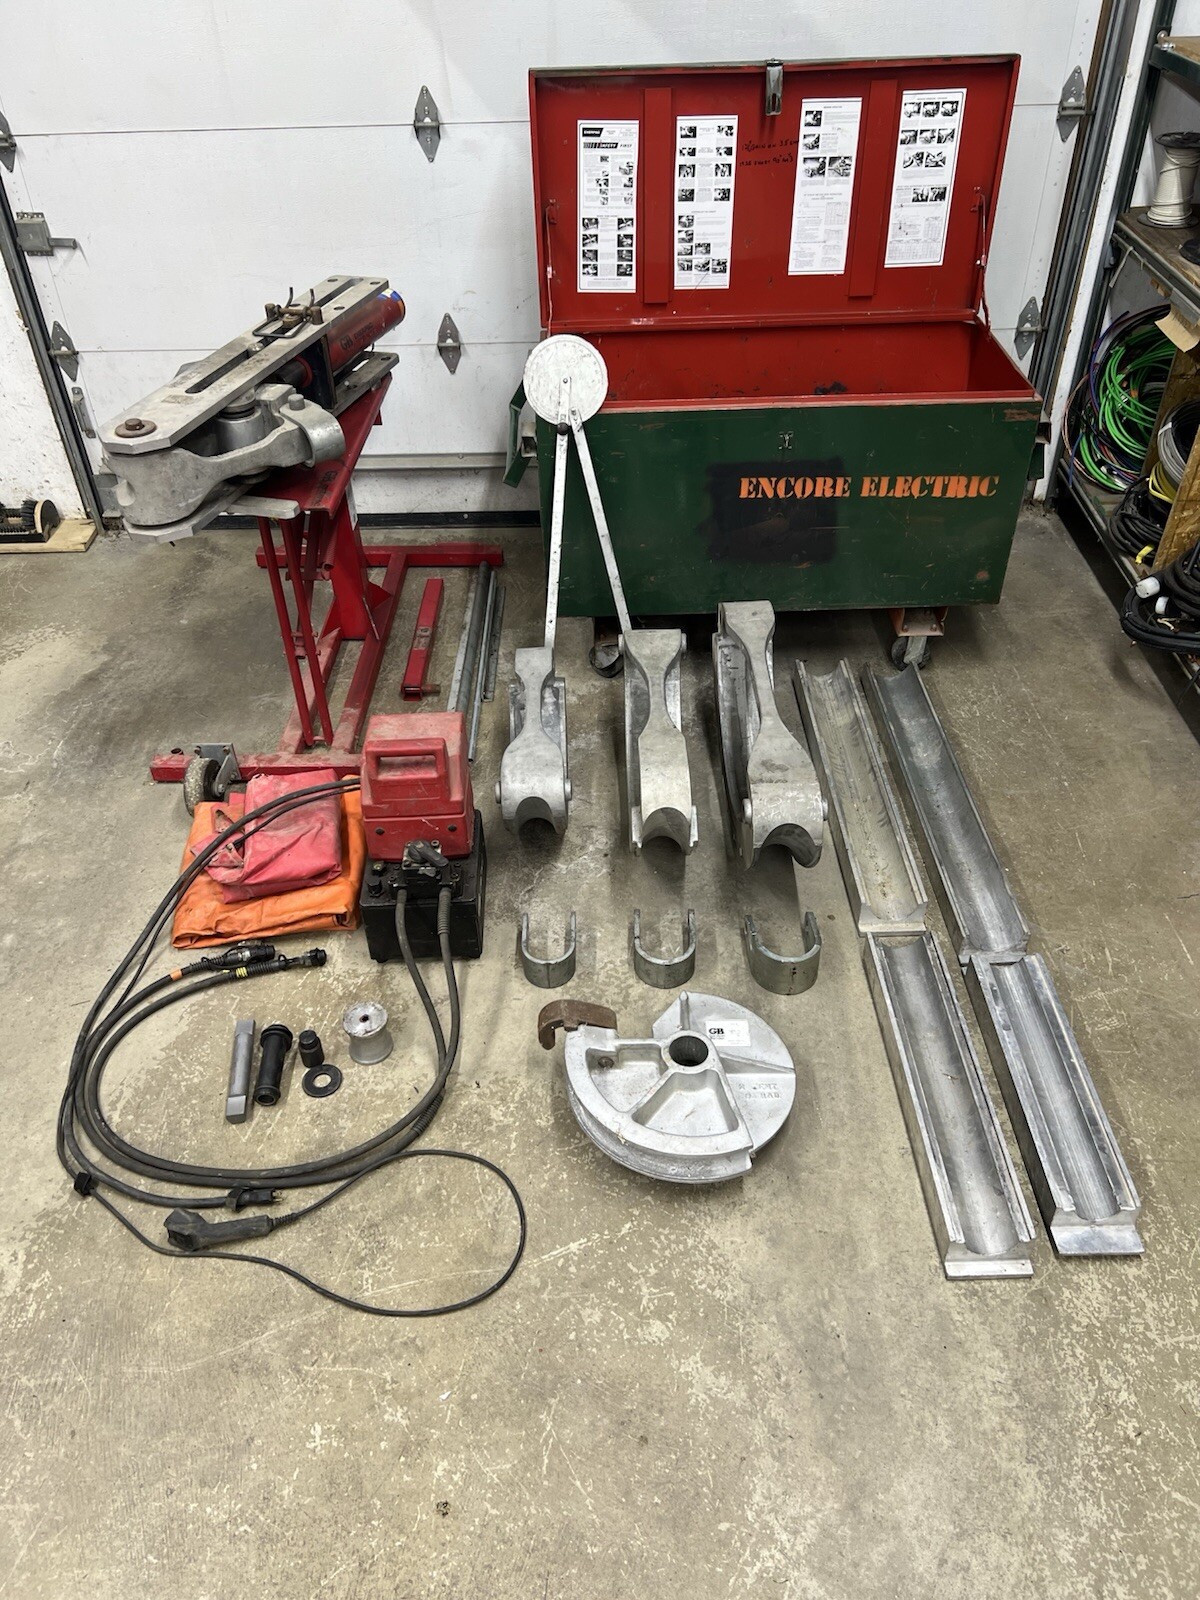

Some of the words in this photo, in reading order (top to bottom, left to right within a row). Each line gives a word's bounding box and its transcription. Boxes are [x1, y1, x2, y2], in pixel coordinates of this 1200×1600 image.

[738, 476, 851, 499] ENCORE
[860, 475, 1000, 499] ELECTRIC
[708, 1027, 724, 1035] GB
